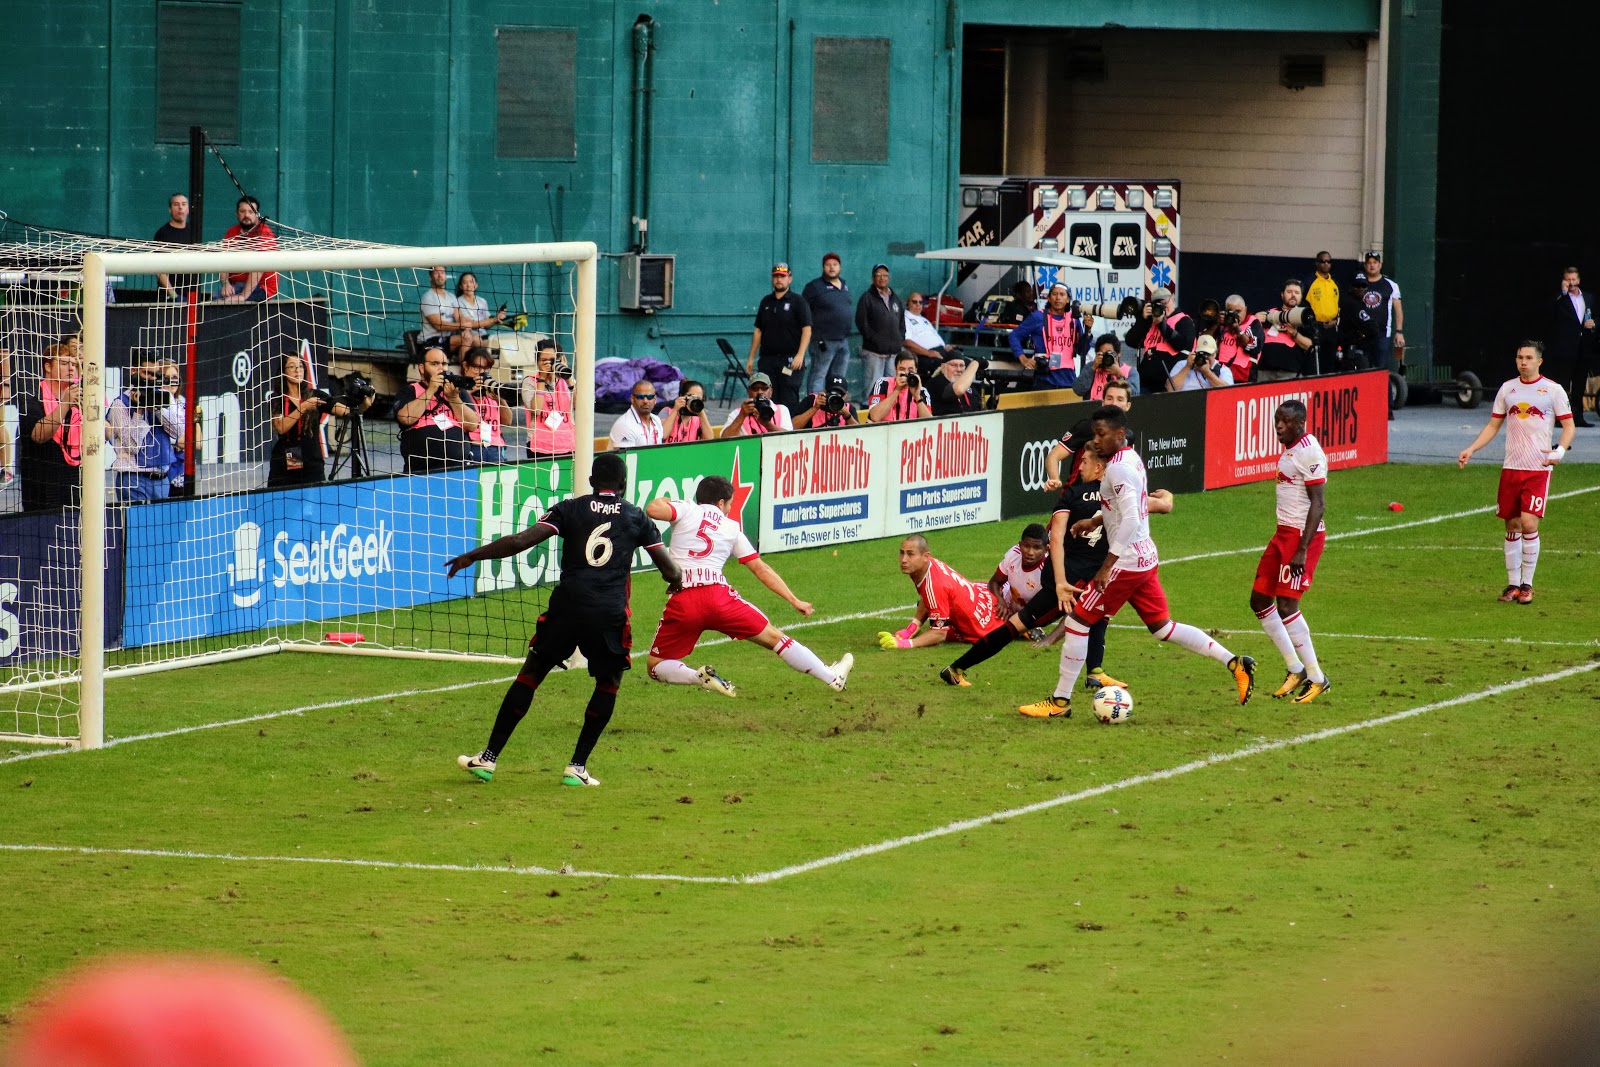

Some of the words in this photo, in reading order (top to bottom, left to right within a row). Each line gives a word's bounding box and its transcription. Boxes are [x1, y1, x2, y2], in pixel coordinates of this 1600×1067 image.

[1313, 386, 1358, 448] CAMPS
[900, 427, 933, 485] Parts
[935, 421, 989, 480] Authority
[1148, 439, 1158, 451] The
[1159, 438, 1171, 450] New
[1171, 436, 1187, 448] Home
[774, 439, 809, 499] Parts
[811, 433, 871, 494] Authority
[1147, 456, 1154, 469] of
[1154, 455, 1165, 468] D.C.
[1165, 453, 1183, 467] United
[1234, 465, 1256, 478] LOCATIONS
[906, 492, 922, 508] Auto
[923, 489, 941, 506] Parts
[942, 485, 981, 504] Superstores
[1528, 494, 1543, 512] 19
[590, 501, 622, 515] OPARE
[781, 508, 799, 523] Auto
[819, 501, 862, 519] Superstores
[925, 513, 952, 528] Answer
[953, 510, 961, 523] Is
[476, 453, 706, 593] Heike
[585, 521, 613, 568] 6
[688, 519, 718, 559] 5
[801, 530, 831, 543] Answer
[833, 527, 840, 540] Is
[273, 519, 393, 588] SeatGeek
[1278, 564, 1292, 584] 10
